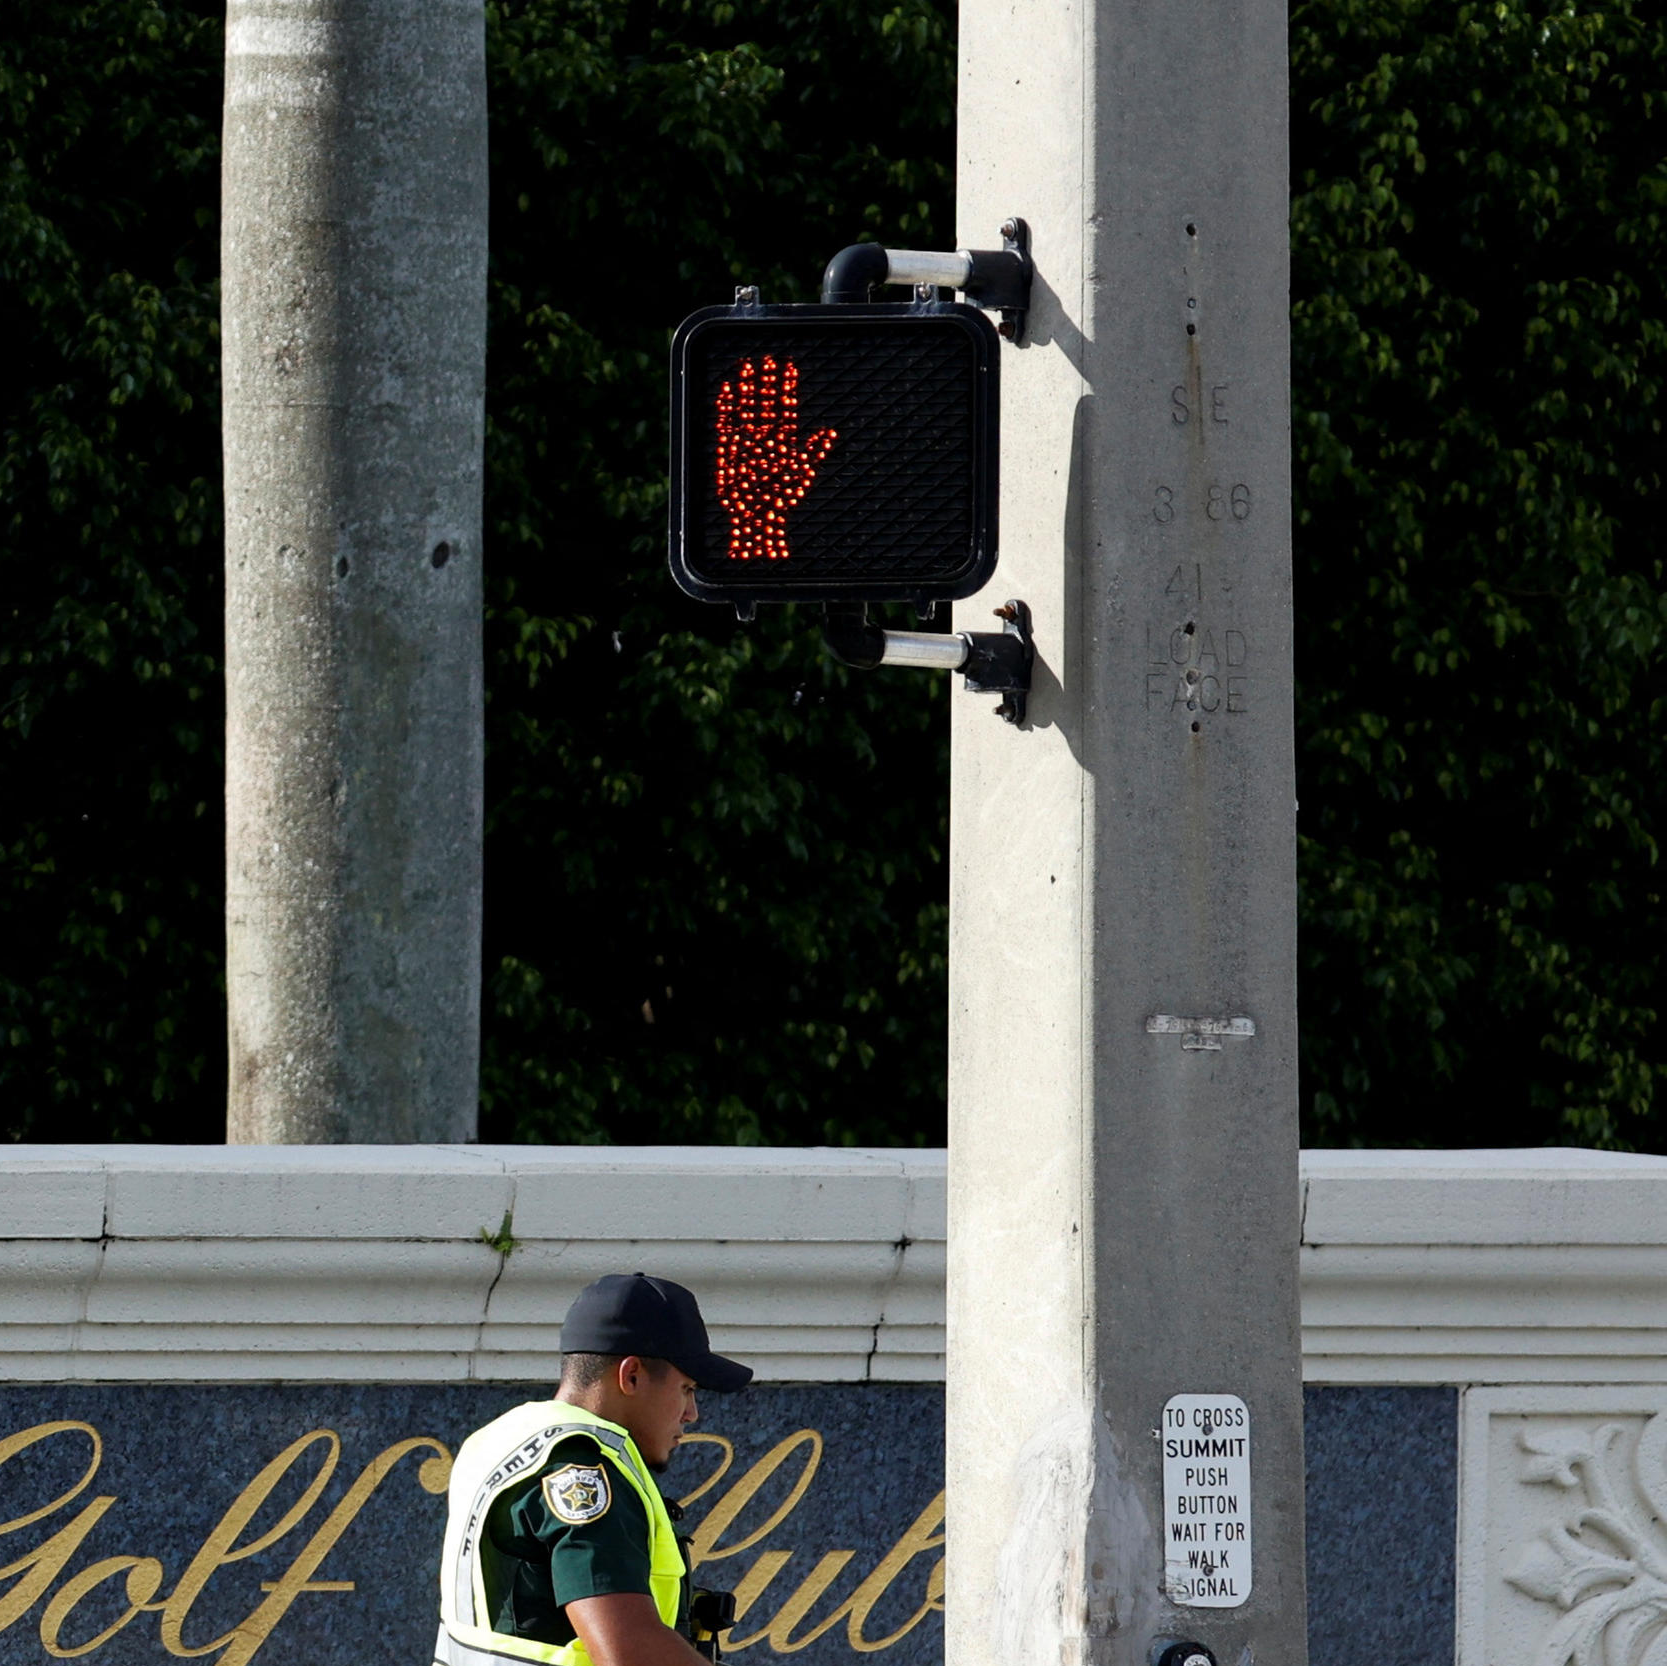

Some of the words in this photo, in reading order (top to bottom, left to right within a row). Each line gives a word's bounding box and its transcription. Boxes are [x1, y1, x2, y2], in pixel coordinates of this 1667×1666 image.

[1146, 628, 1248, 668] LOAD
[1146, 672, 1248, 713] FACE
[1166, 1408, 1185, 1428] TO
[1193, 1407, 1244, 1428] CROSS
[1166, 1438, 1246, 1458] SUMMIT
[1185, 1467, 1228, 1487] PUSH
[462, 1426, 563, 1557] SHERIFF
[1178, 1495, 1237, 1514] BUTTON
[1171, 1523, 1207, 1542] WAIT
[1215, 1522, 1245, 1541] FOR
[1188, 1550, 1229, 1569] WALK
